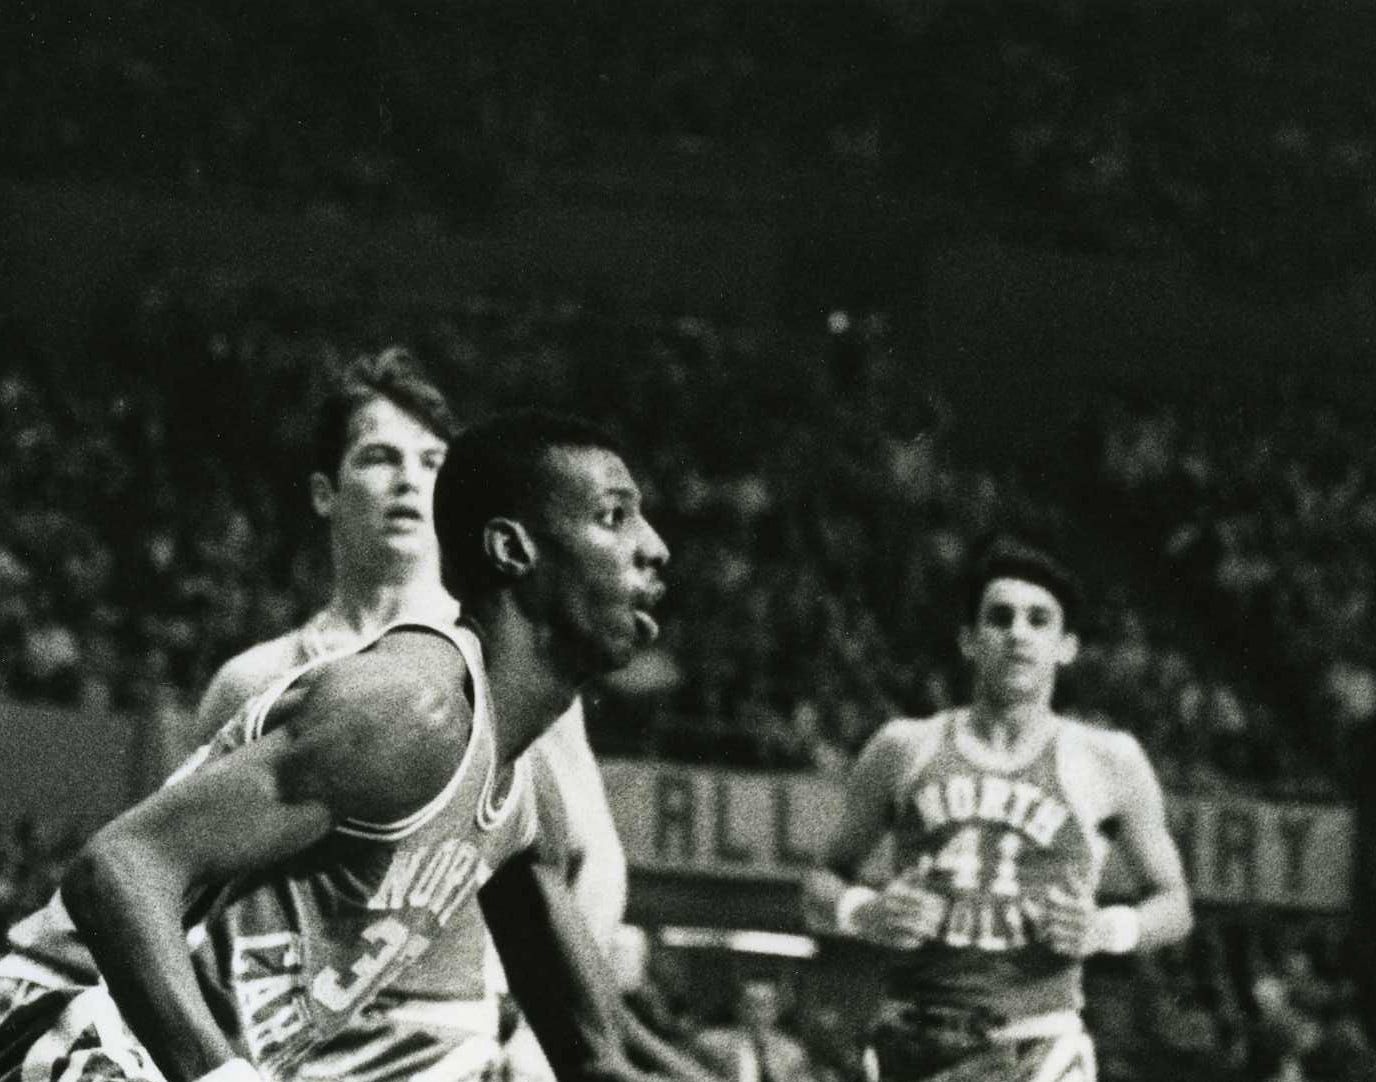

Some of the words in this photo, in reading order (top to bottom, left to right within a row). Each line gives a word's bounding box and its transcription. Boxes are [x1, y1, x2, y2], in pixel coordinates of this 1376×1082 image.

[654, 773, 817, 867] ALL
[1177, 806, 1313, 896] AY
[915, 773, 1069, 847] NORTH
[934, 826, 1024, 896] 41
